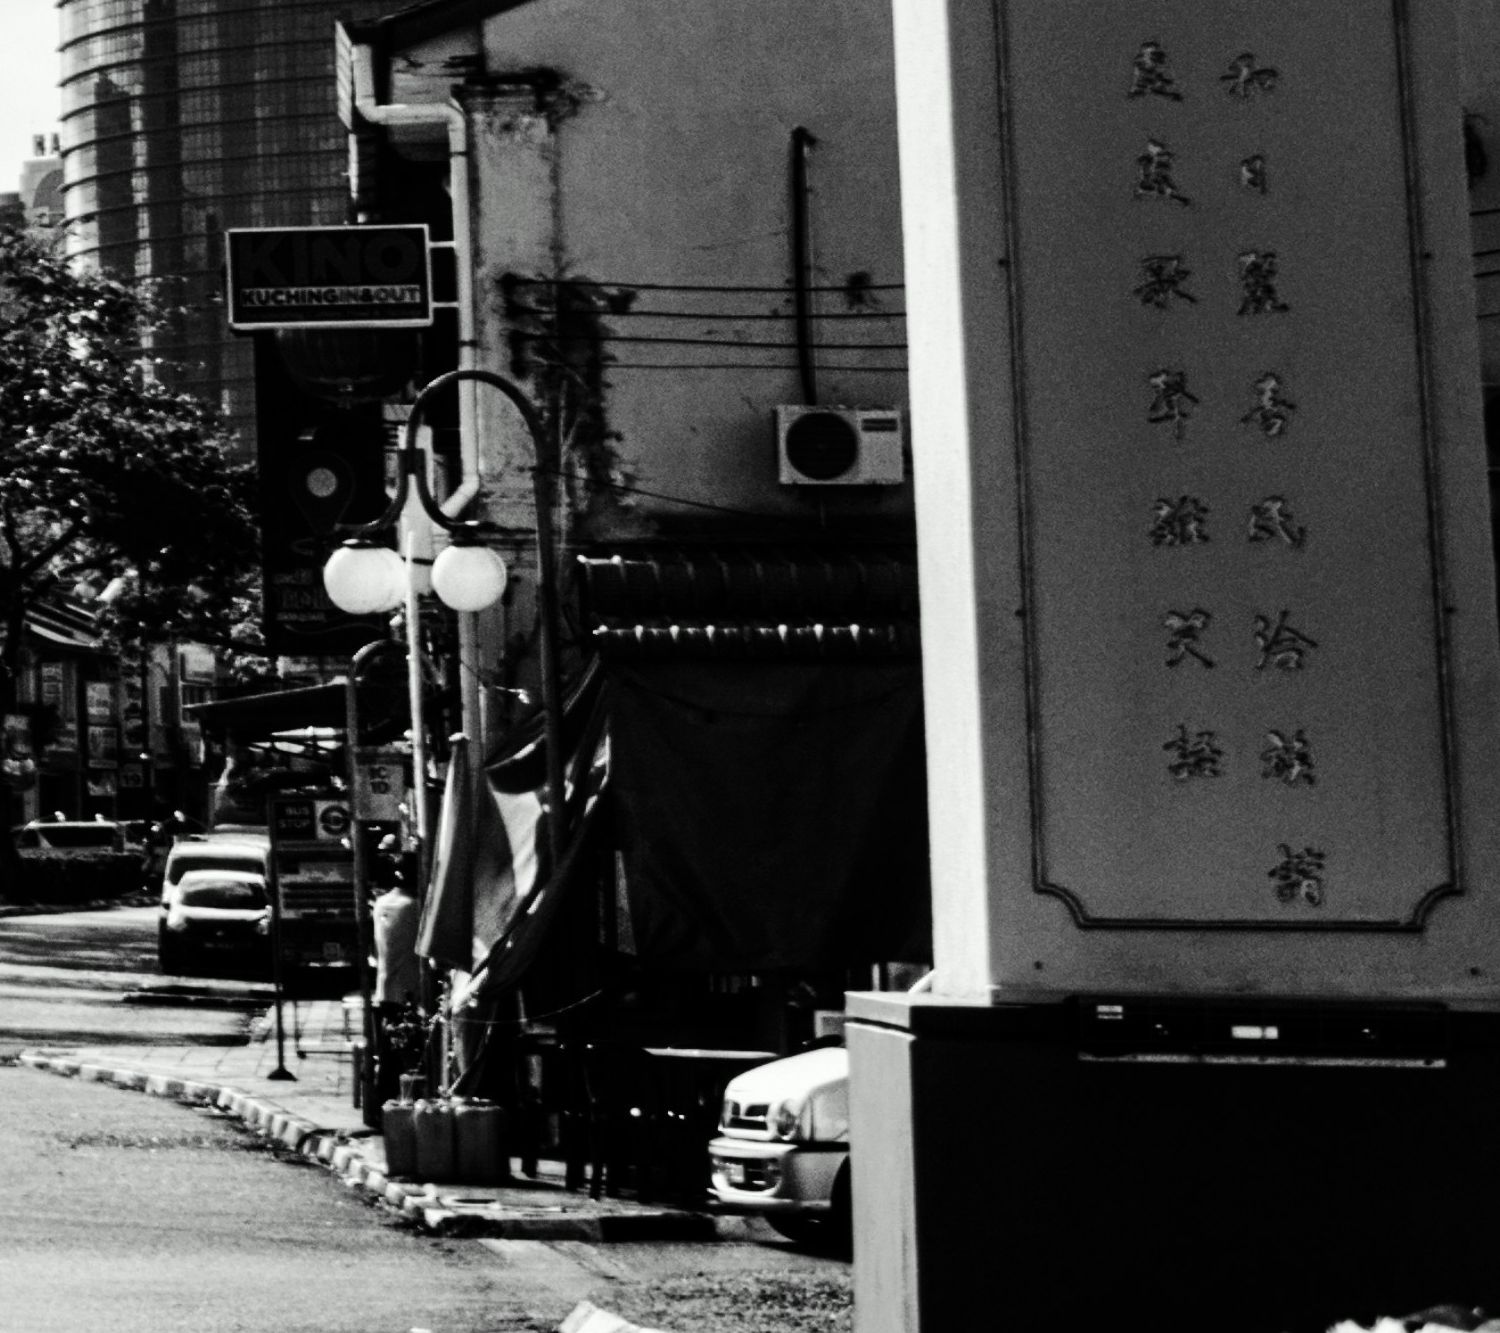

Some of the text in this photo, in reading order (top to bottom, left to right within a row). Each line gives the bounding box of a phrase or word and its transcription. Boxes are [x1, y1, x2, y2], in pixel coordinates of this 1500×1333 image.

[237, 230, 420, 287] KINO
[284, 804, 311, 818] BUS
[278, 817, 312, 830] STOP
